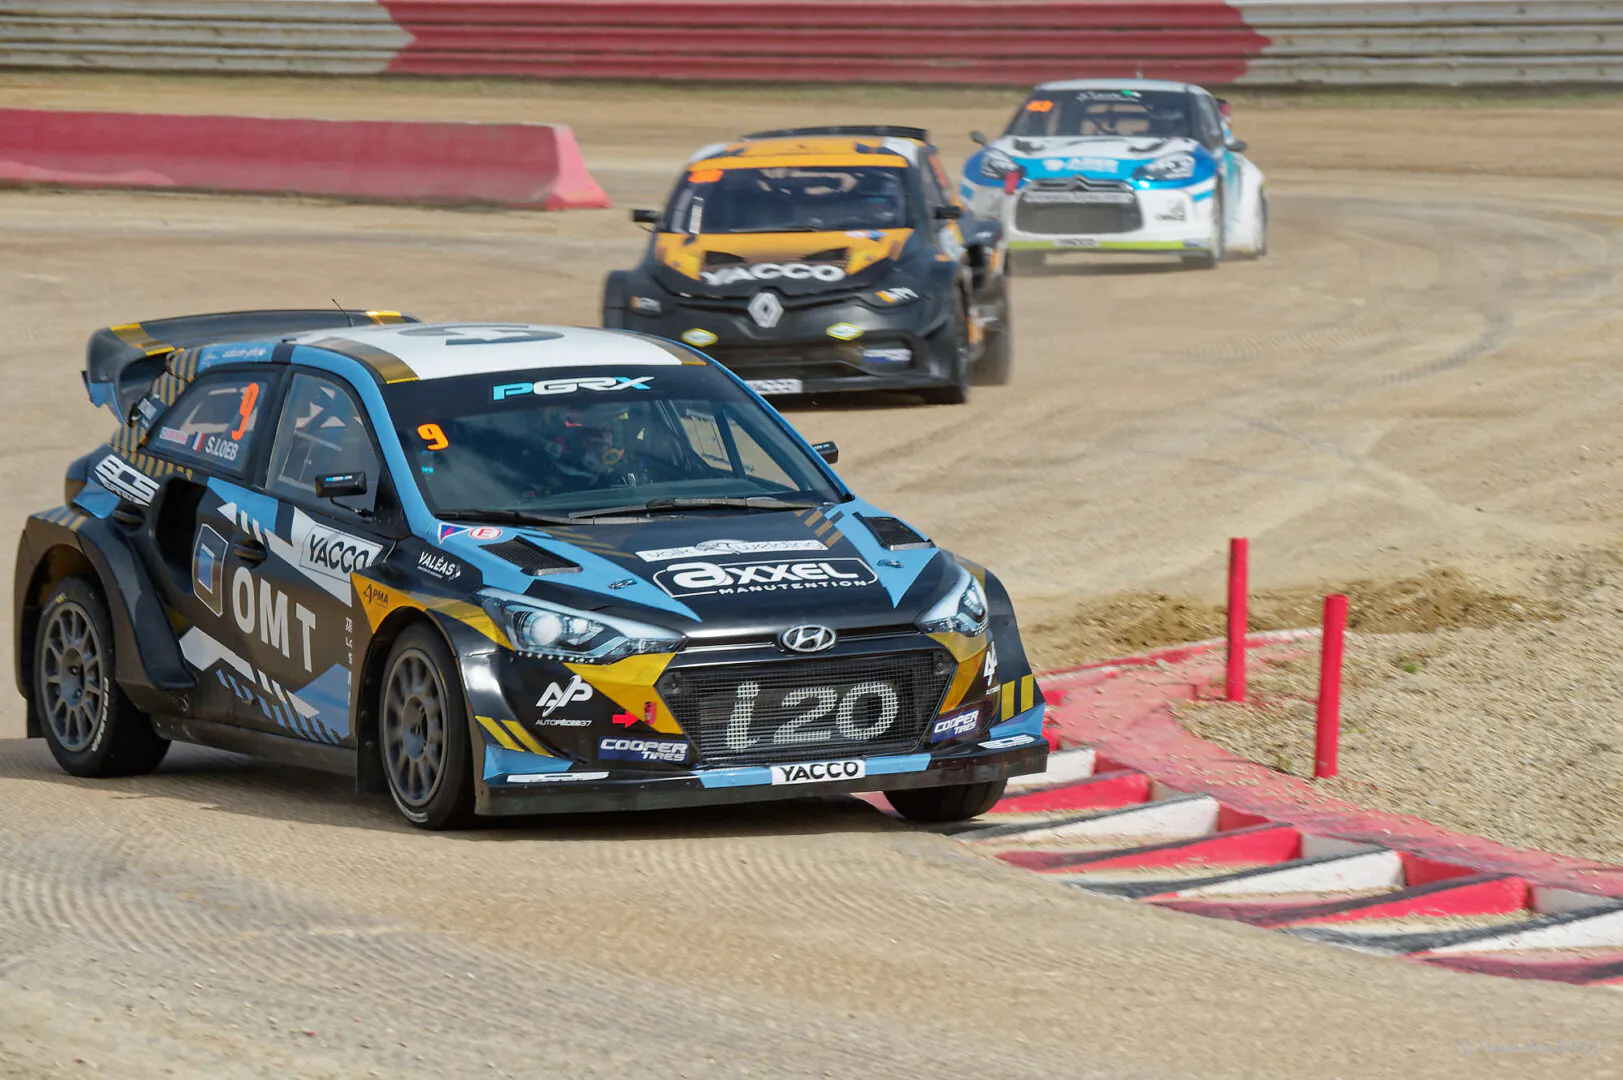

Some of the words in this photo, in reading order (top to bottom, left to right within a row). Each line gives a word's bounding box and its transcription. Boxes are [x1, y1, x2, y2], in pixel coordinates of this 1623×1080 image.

[700, 261, 845, 286] YACCO
[492, 376, 656, 401] PGRX
[231, 382, 260, 441] 9
[205, 435, 239, 461] S.LOEB
[416, 423, 449, 451] 9
[308, 534, 370, 573] YACCO
[418, 551, 456, 576] VALÉAS
[718, 579, 869, 595] MANUTENTION
[232, 566, 317, 673] OMT
[933, 710, 980, 734] COOPER
[953, 721, 977, 735] TIRES
[600, 738, 688, 753] COOPER
[642, 751, 685, 762] TIRES
[779, 761, 859, 782] YACCO
